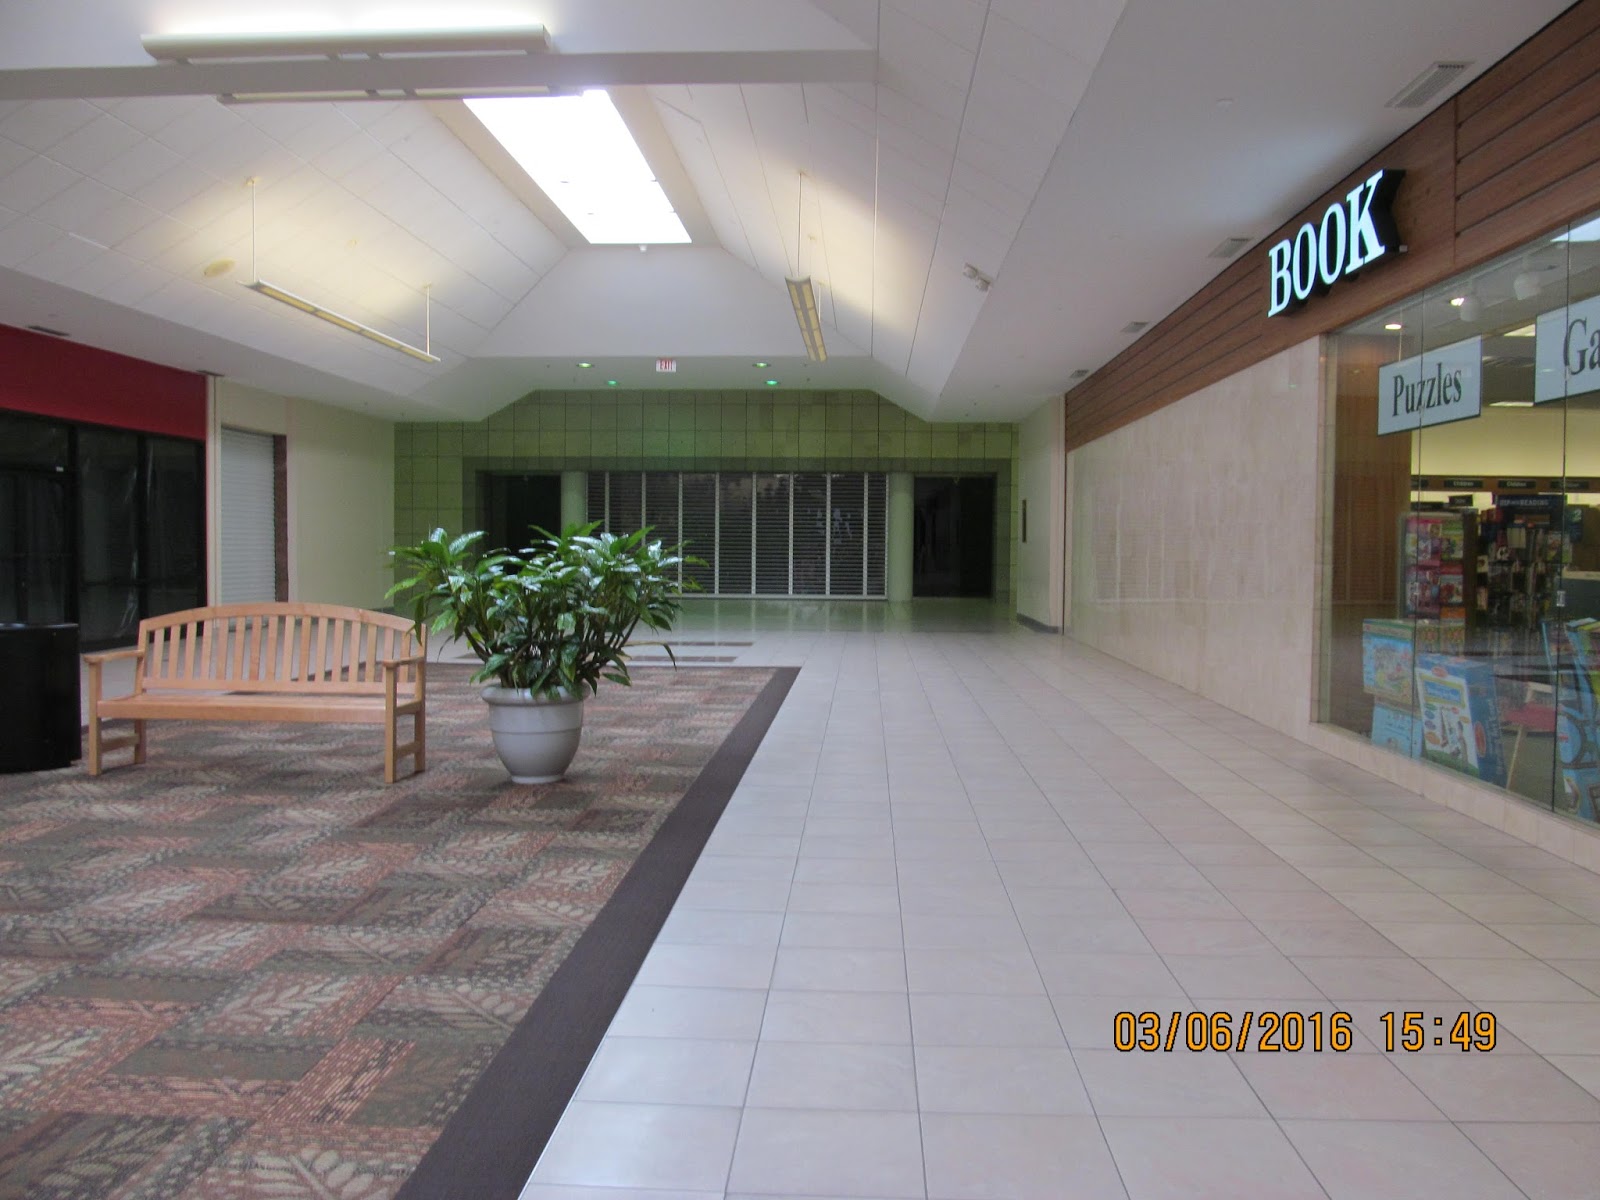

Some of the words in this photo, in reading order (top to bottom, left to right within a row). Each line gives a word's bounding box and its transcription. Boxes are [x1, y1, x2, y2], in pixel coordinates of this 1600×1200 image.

[1267, 168, 1386, 318] BOOK
[659, 359, 673, 370] EXIT
[1392, 362, 1462, 417] Puzzles
